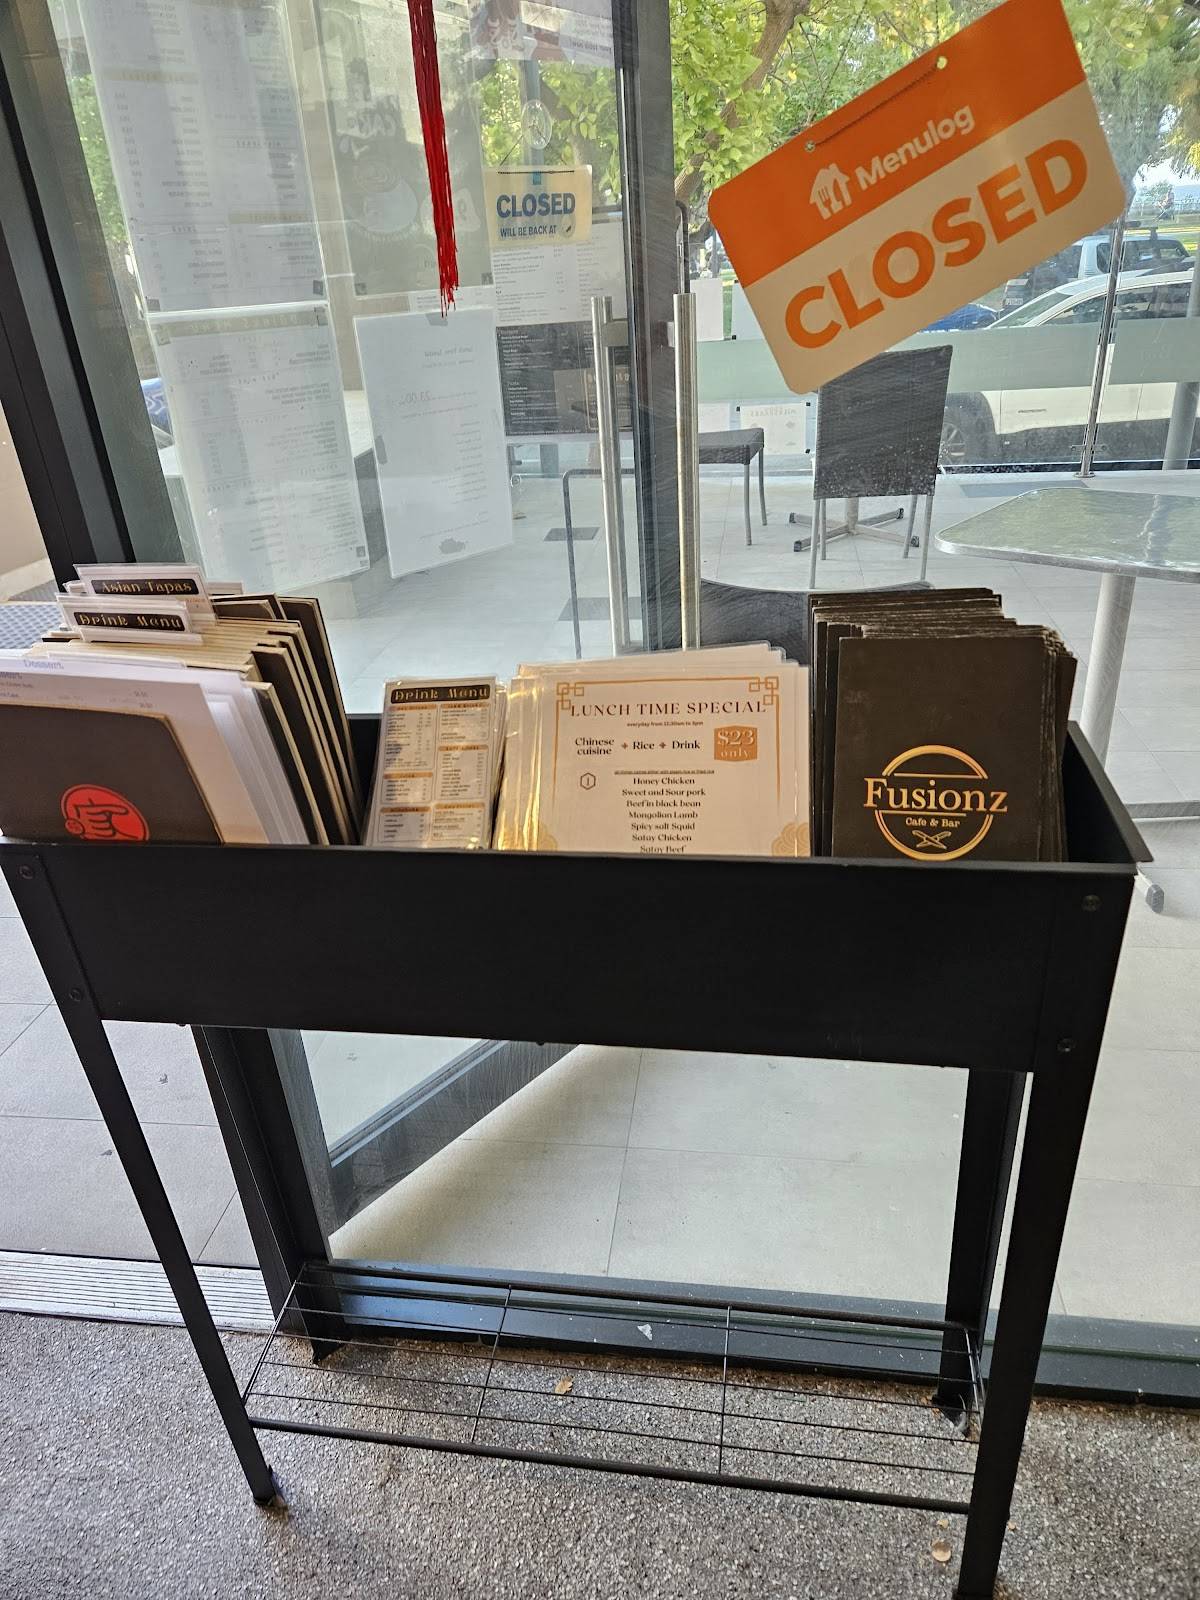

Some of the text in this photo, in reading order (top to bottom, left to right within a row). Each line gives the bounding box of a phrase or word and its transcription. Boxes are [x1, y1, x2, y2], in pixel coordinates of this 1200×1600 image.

[855, 105, 975, 190] Menulog
[496, 192, 576, 218] CLOSED
[500, 225, 557, 237] WILL BE BACK AT
[785, 139, 1088, 348] CLOSED
[102, 581, 192, 594] Asian Tapas
[79, 614, 181, 628] Drink Menu
[395, 688, 488, 700] Drink Menu
[571, 701, 766, 717] LUNCH TIME SPECIAL
[575, 737, 615, 747] Chinese
[716, 729, 755, 746] $23
[633, 740, 655, 751] Rice
[671, 740, 701, 750] Drink
[576, 747, 612, 756] cuisine
[720, 749, 751, 760] only
[633, 777, 695, 786] Honey Chicken
[648, 788, 664, 796] and
[686, 788, 706, 797] pork
[863, 777, 1008, 813] Fusionz
[628, 811, 698, 820] Mongolian Lamb
[631, 822, 653, 831] Spicy
[671, 822, 695, 831] Squid
[905, 817, 961, 828] Cafe & Bar
[632, 834, 655, 842] Satay
[640, 845, 687, 853] Satay Beef
